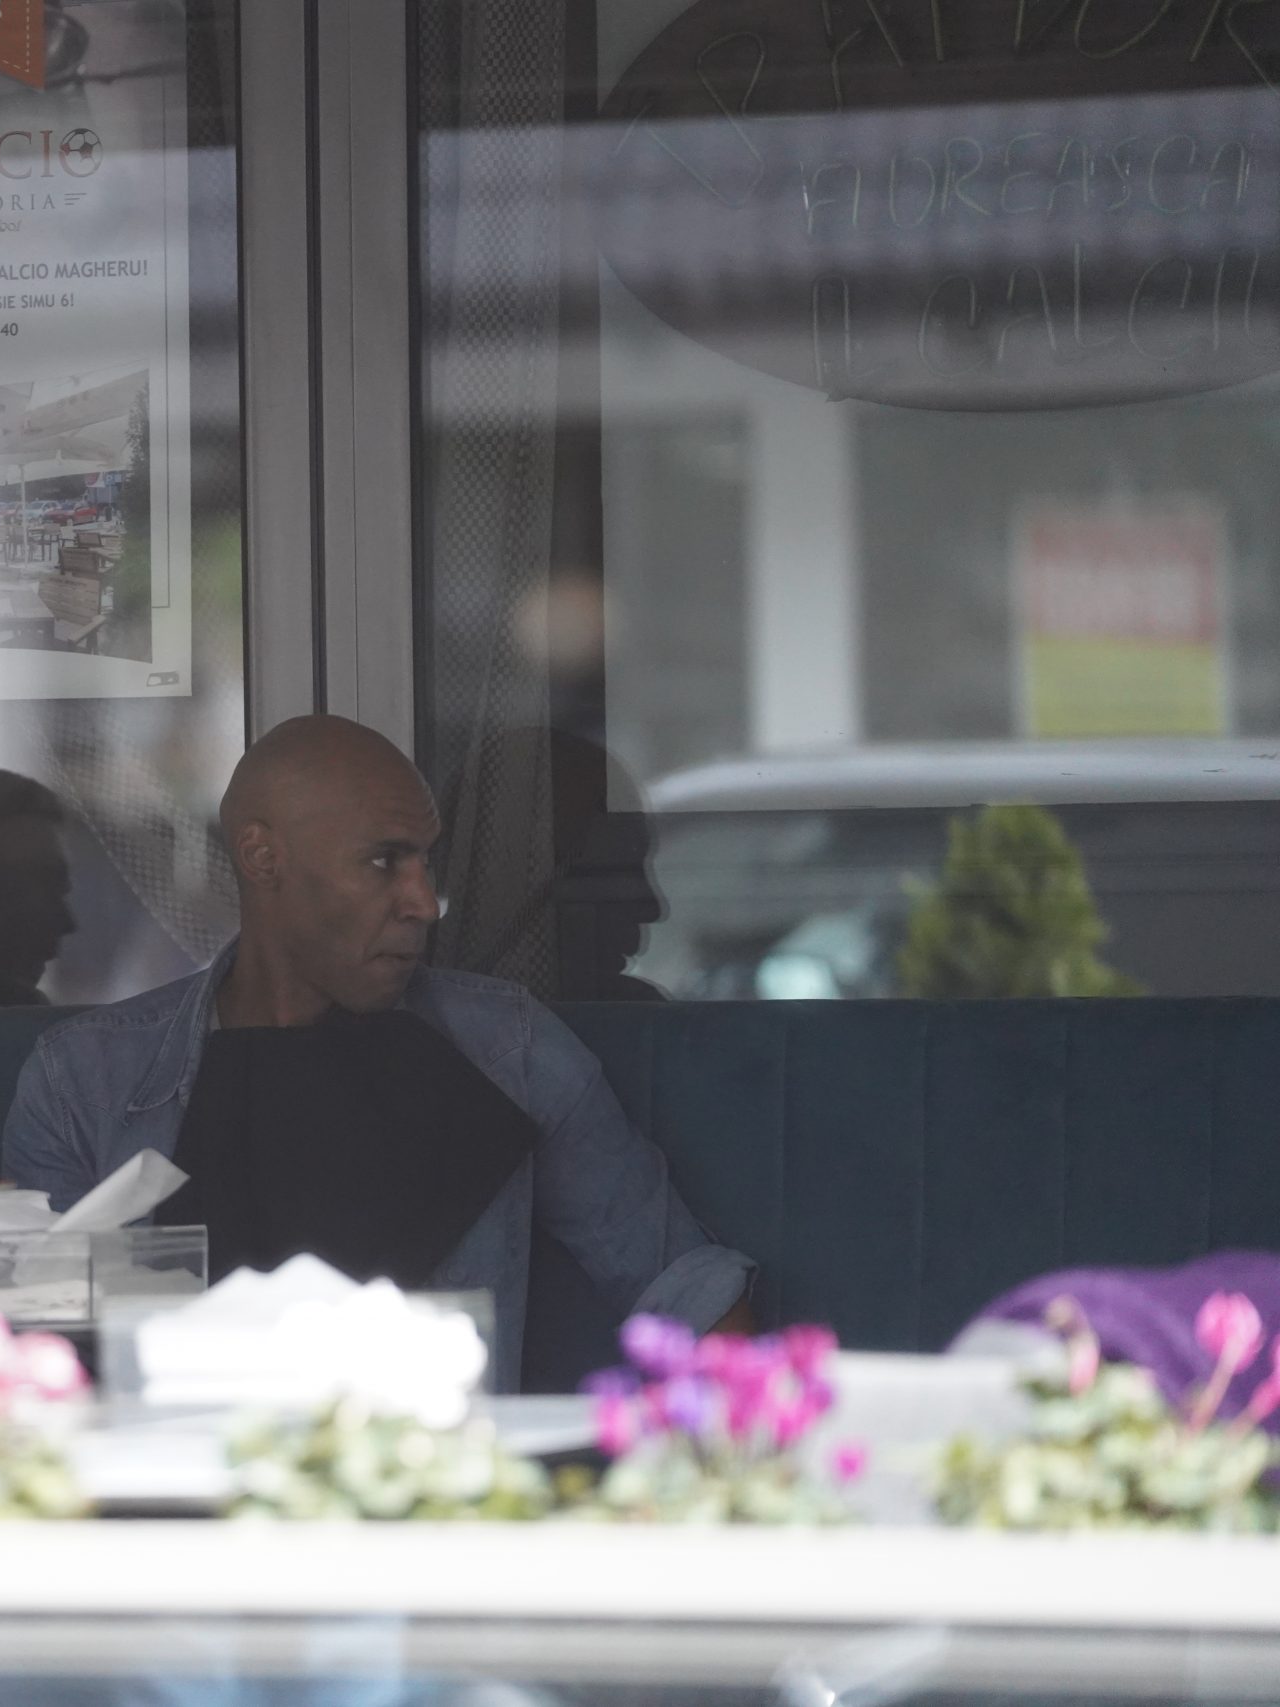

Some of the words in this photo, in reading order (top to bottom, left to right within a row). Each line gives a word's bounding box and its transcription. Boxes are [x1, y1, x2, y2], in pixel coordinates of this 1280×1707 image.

[55, 259, 148, 279] MAGHERU!
[21, 294, 56, 309] SIMU
[60, 293, 75, 308] 6!
